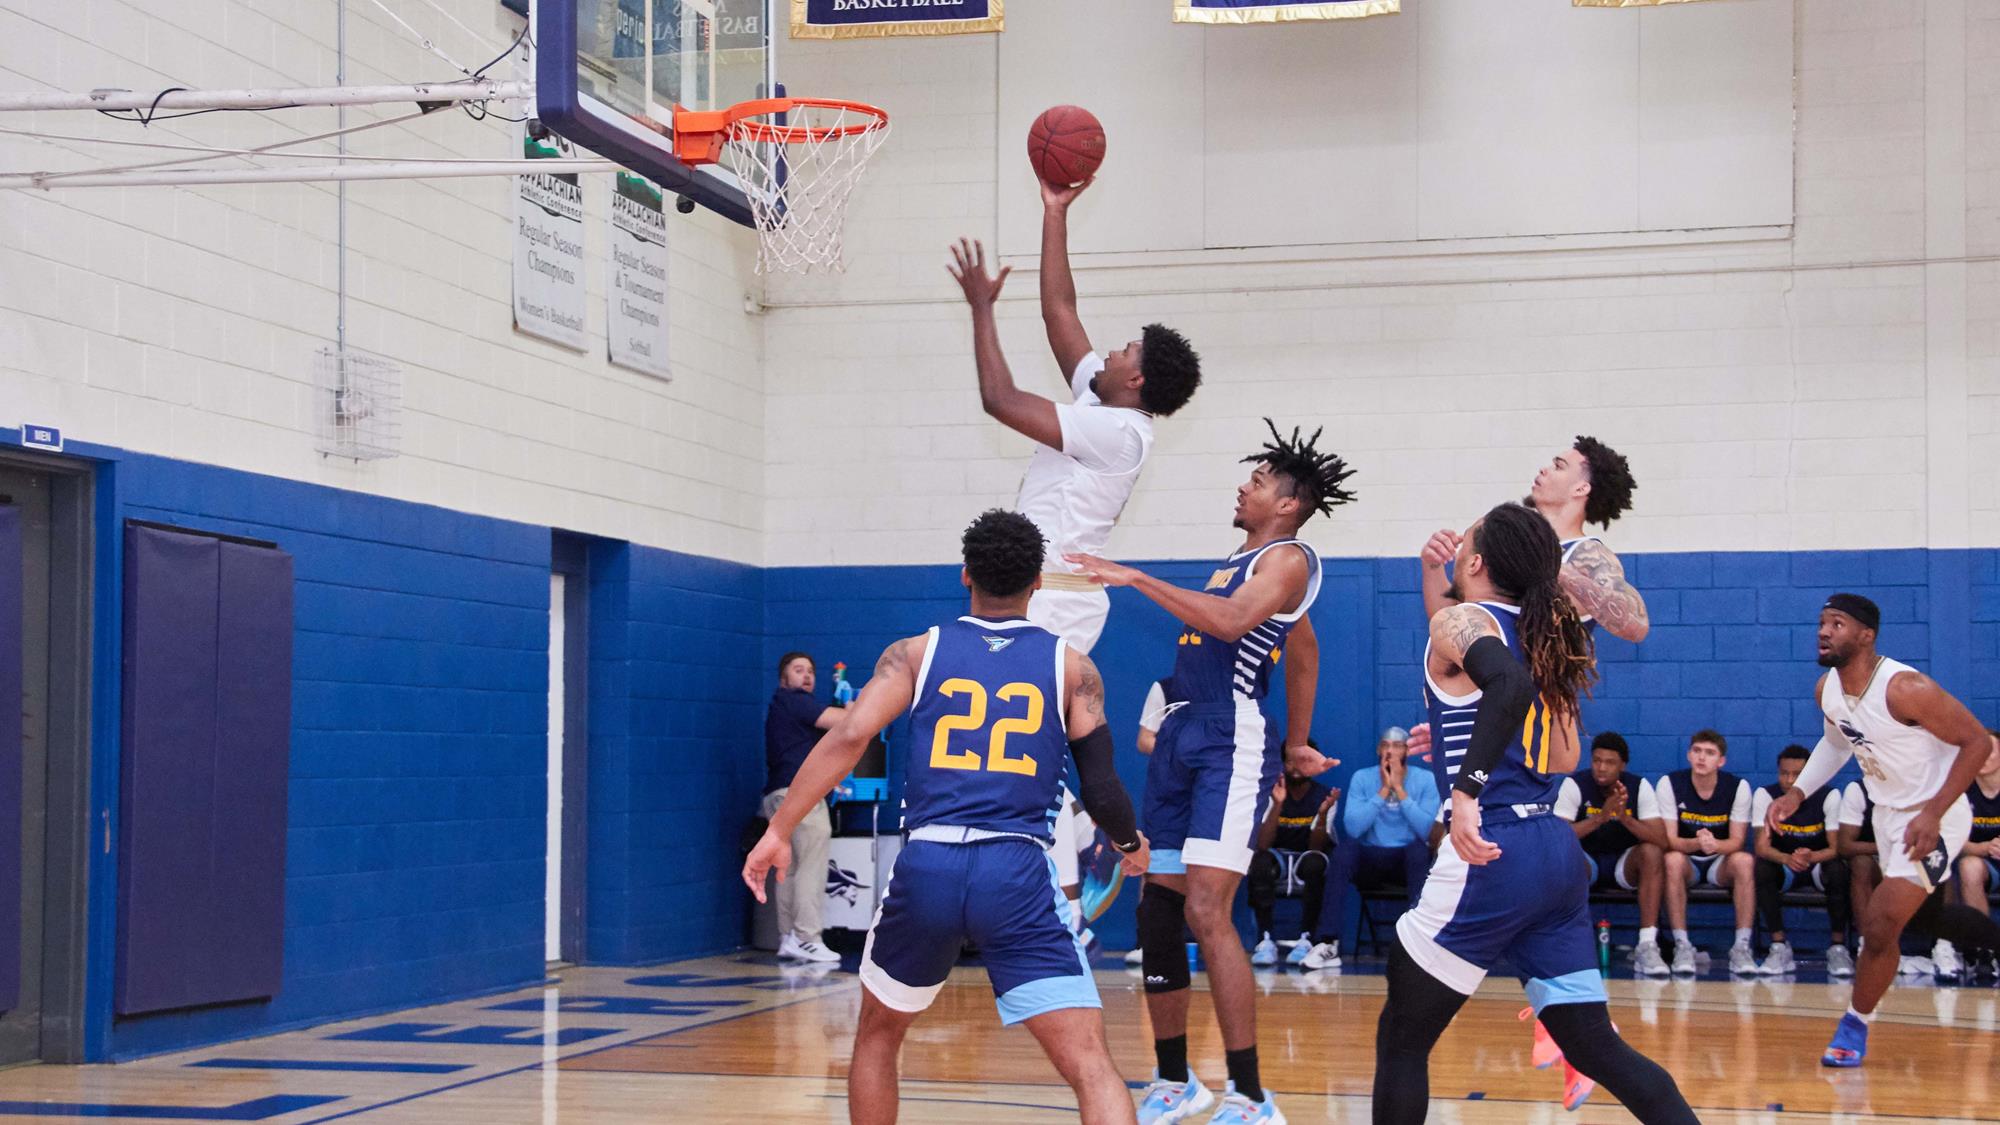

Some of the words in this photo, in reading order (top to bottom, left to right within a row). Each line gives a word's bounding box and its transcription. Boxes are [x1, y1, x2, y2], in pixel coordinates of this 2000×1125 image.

[832, 0, 964, 11] BASKE
[546, 195, 583, 218] Conference
[612, 193, 666, 231] APPALACHIAN
[519, 215, 551, 246] Regular
[553, 231, 583, 259] Season
[528, 250, 576, 284] Champions
[613, 244, 640, 271] Regular
[641, 256, 666, 280] Season
[624, 273, 664, 305] Tournament
[551, 307, 583, 332] Basketball
[621, 298, 660, 327] Champions
[930, 678, 1044, 776] 22
